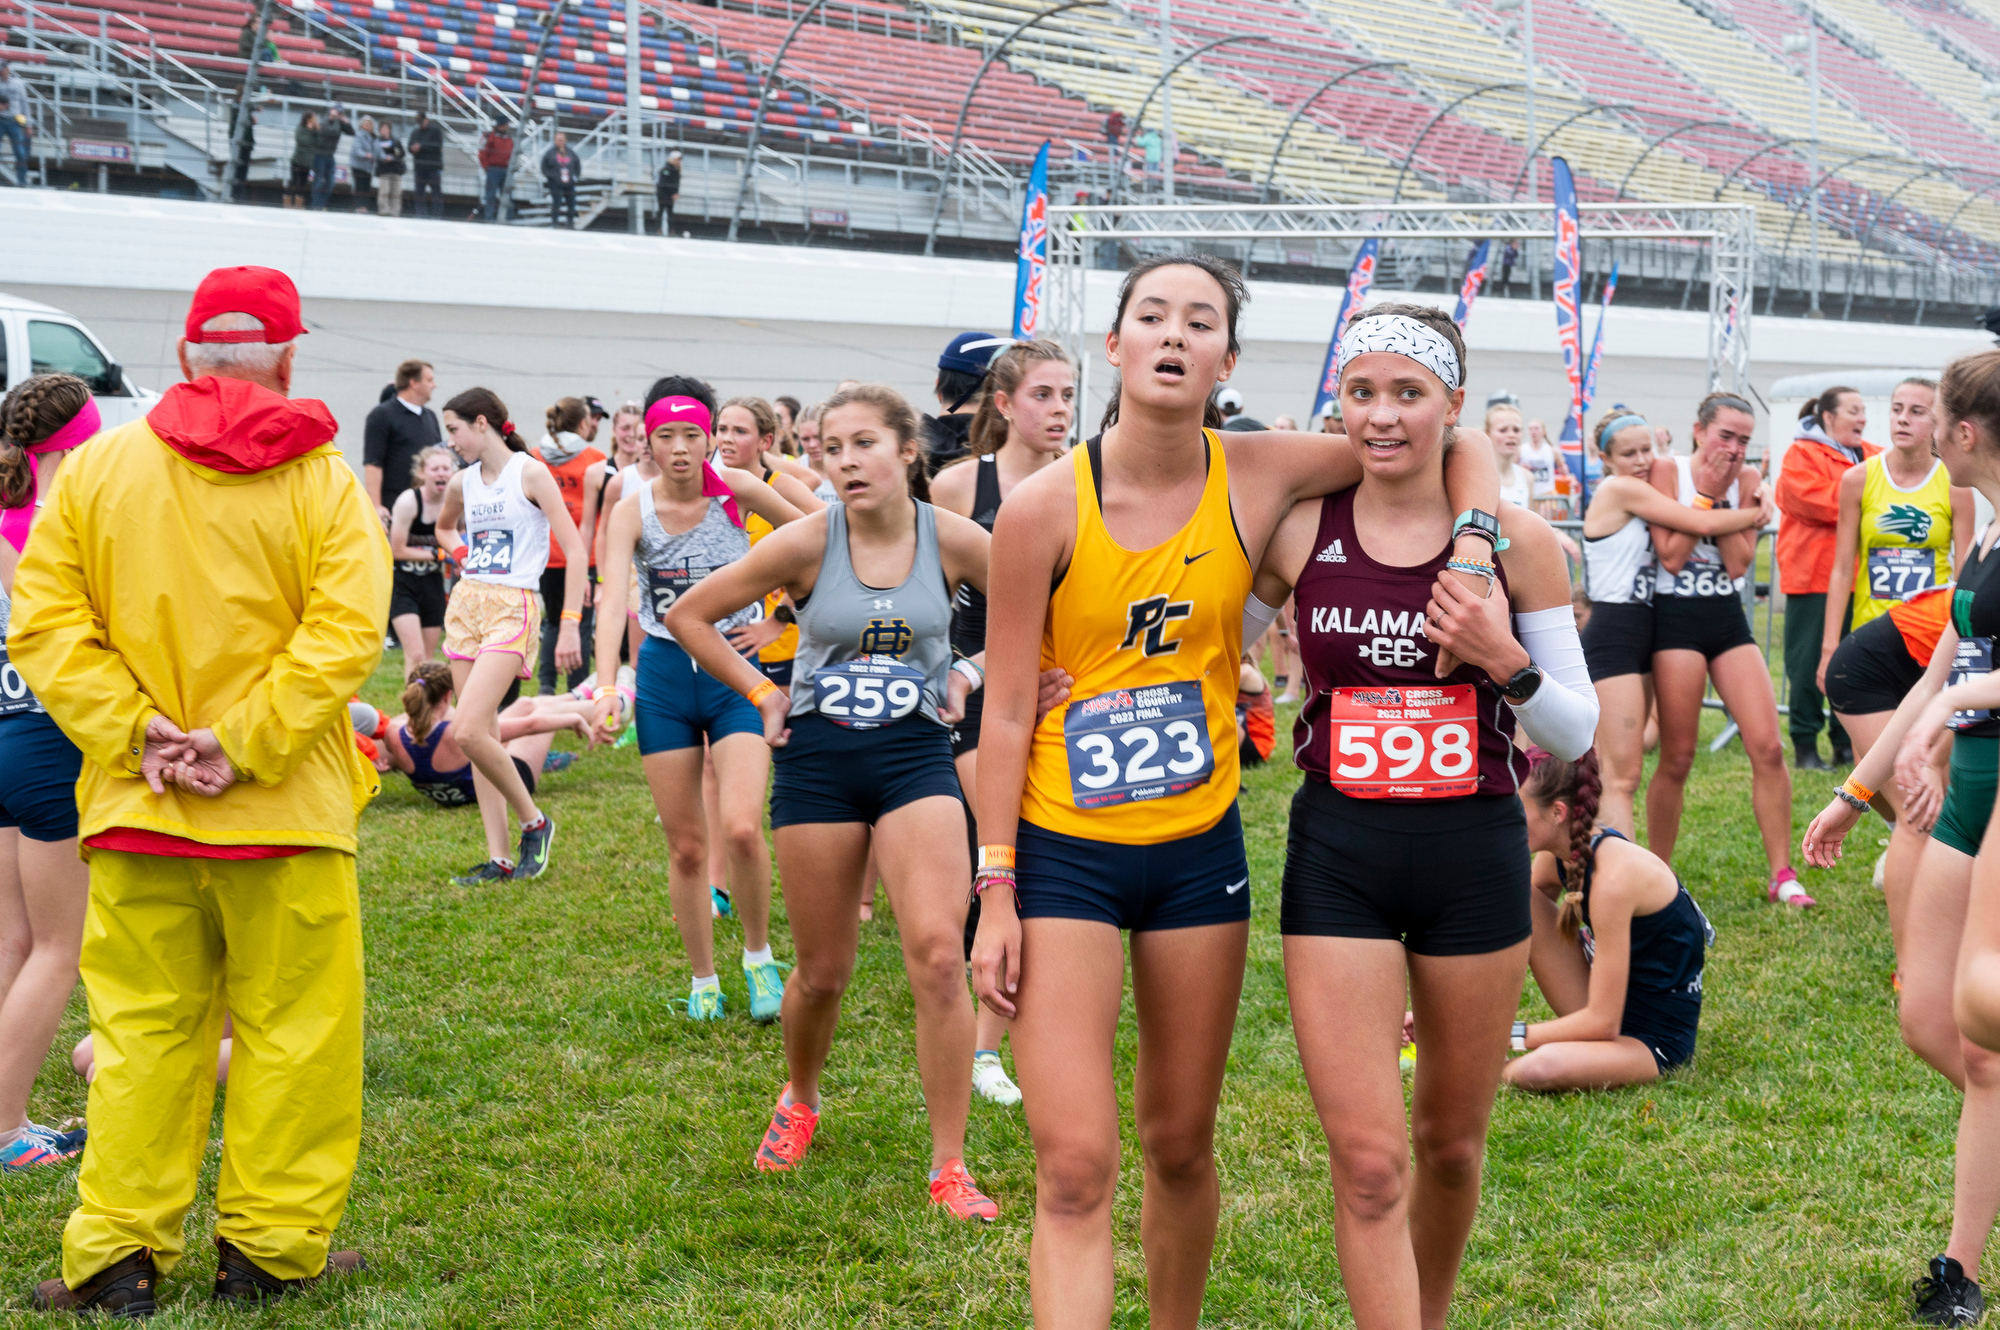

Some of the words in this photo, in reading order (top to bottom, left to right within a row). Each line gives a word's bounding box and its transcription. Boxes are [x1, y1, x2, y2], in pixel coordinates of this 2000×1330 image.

[466, 545, 510, 568] 264
[1316, 553, 1347, 563] adidas
[1675, 570, 1734, 596] 368
[1872, 566, 1931, 592] 277
[1117, 593, 1194, 658] PC
[1311, 607, 1428, 638] KALAMA
[1371, 637, 1415, 667] CC
[819, 676, 919, 718] 259
[1136, 686, 1170, 700] CROSS
[1137, 692, 1182, 708] COUNTRY
[1351, 689, 1401, 705] MHSAA
[1405, 689, 1443, 699] CROSS
[1405, 697, 1456, 707] COUNTRY
[1109, 711, 1135, 725] 2022
[1136, 707, 1164, 720] FINAL
[1377, 709, 1402, 719] 2022
[1404, 709, 1432, 719] FINAL
[1076, 720, 1205, 789] 323
[1336, 723, 1473, 779] 598
